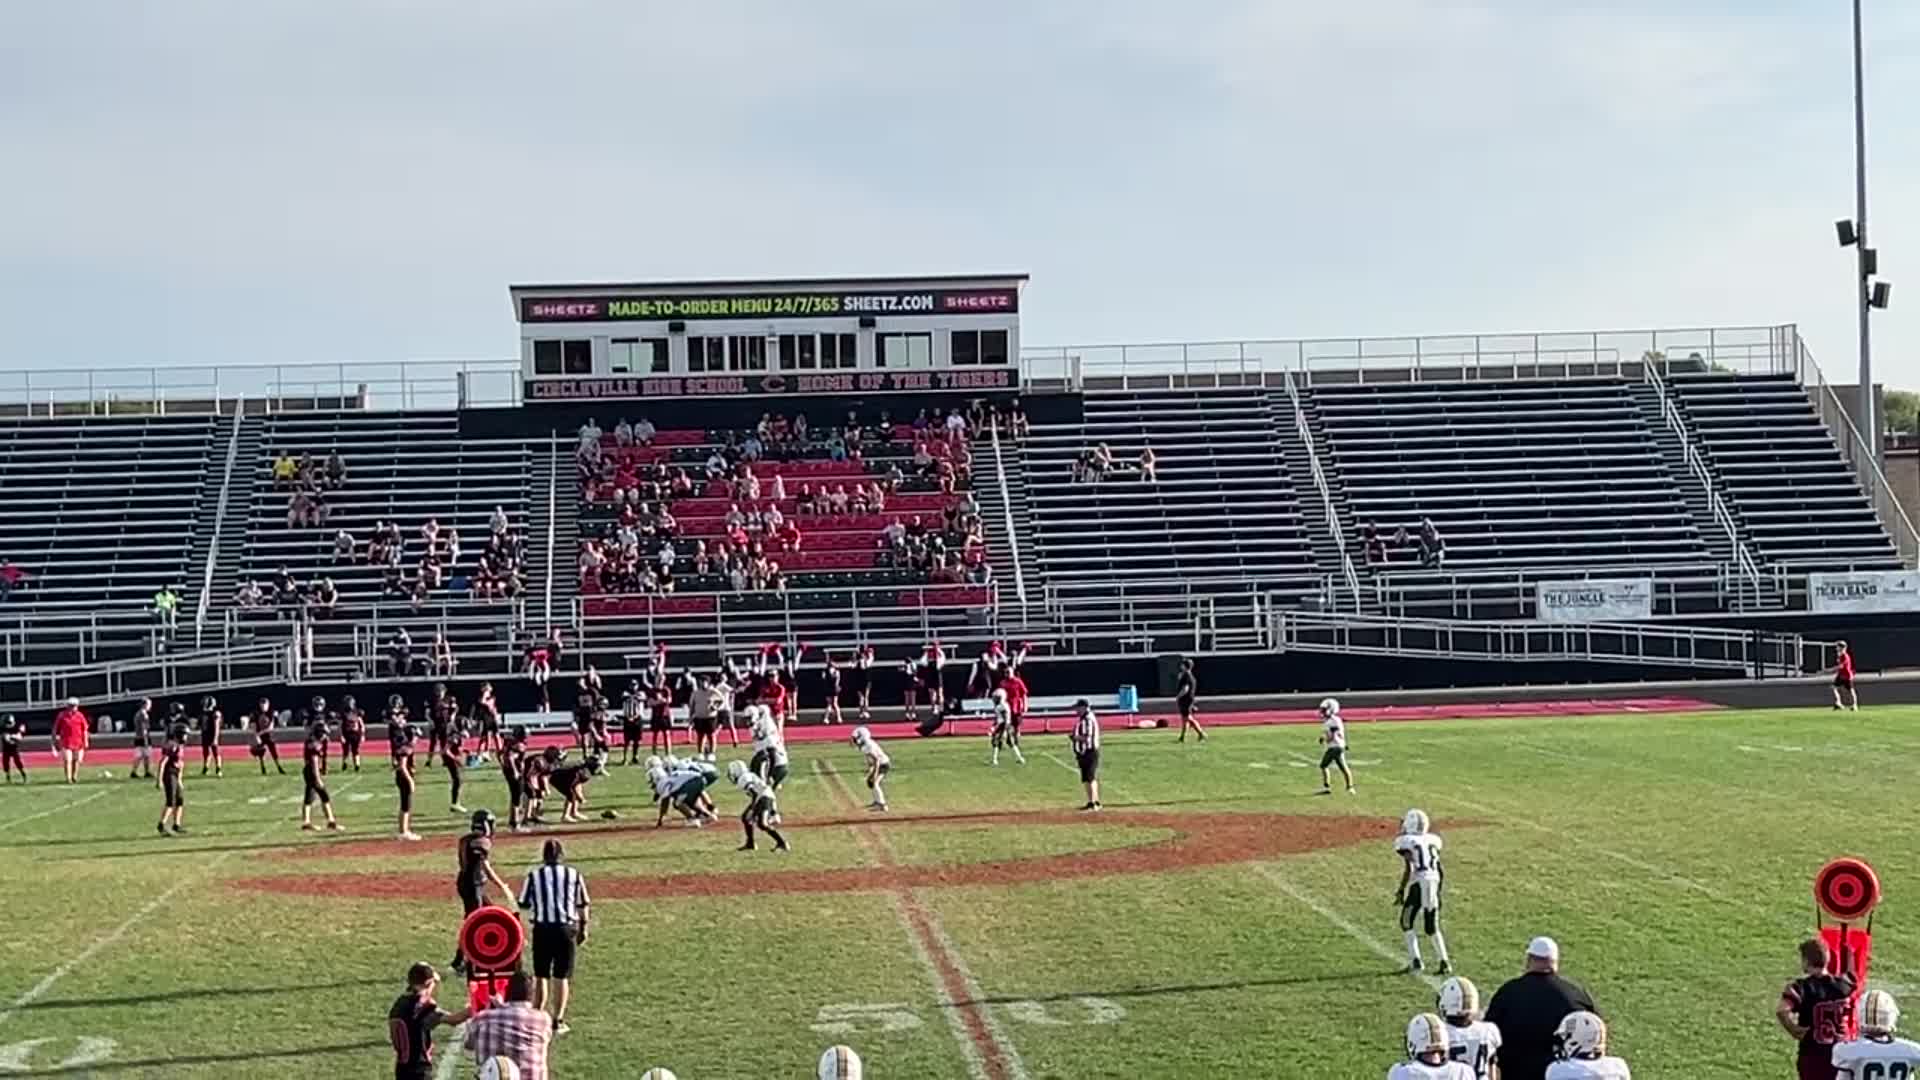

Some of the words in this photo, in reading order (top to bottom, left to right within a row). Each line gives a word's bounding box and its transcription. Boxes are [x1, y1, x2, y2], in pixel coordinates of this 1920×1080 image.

[532, 303, 598, 316] SHEETZ
[608, 299, 728, 316] MADE-TO-ORDER
[732, 298, 772, 314] MENU
[774, 296, 840, 314] 24/7/365
[843, 294, 934, 312] SHEETZ.COM
[946, 295, 1009, 308] SHEETZ
[532, 379, 639, 398] CIRCLEVILLE
[642, 378, 683, 396] HIGH
[685, 377, 748, 394] SCHOOL
[797, 374, 854, 392] HOME
[859, 374, 885, 390] OF
[890, 373, 932, 389] THE
[937, 371, 1009, 388] TIGERS
[1543, 592, 1564, 606] THE
[1566, 591, 1606, 605] JUNGLE
